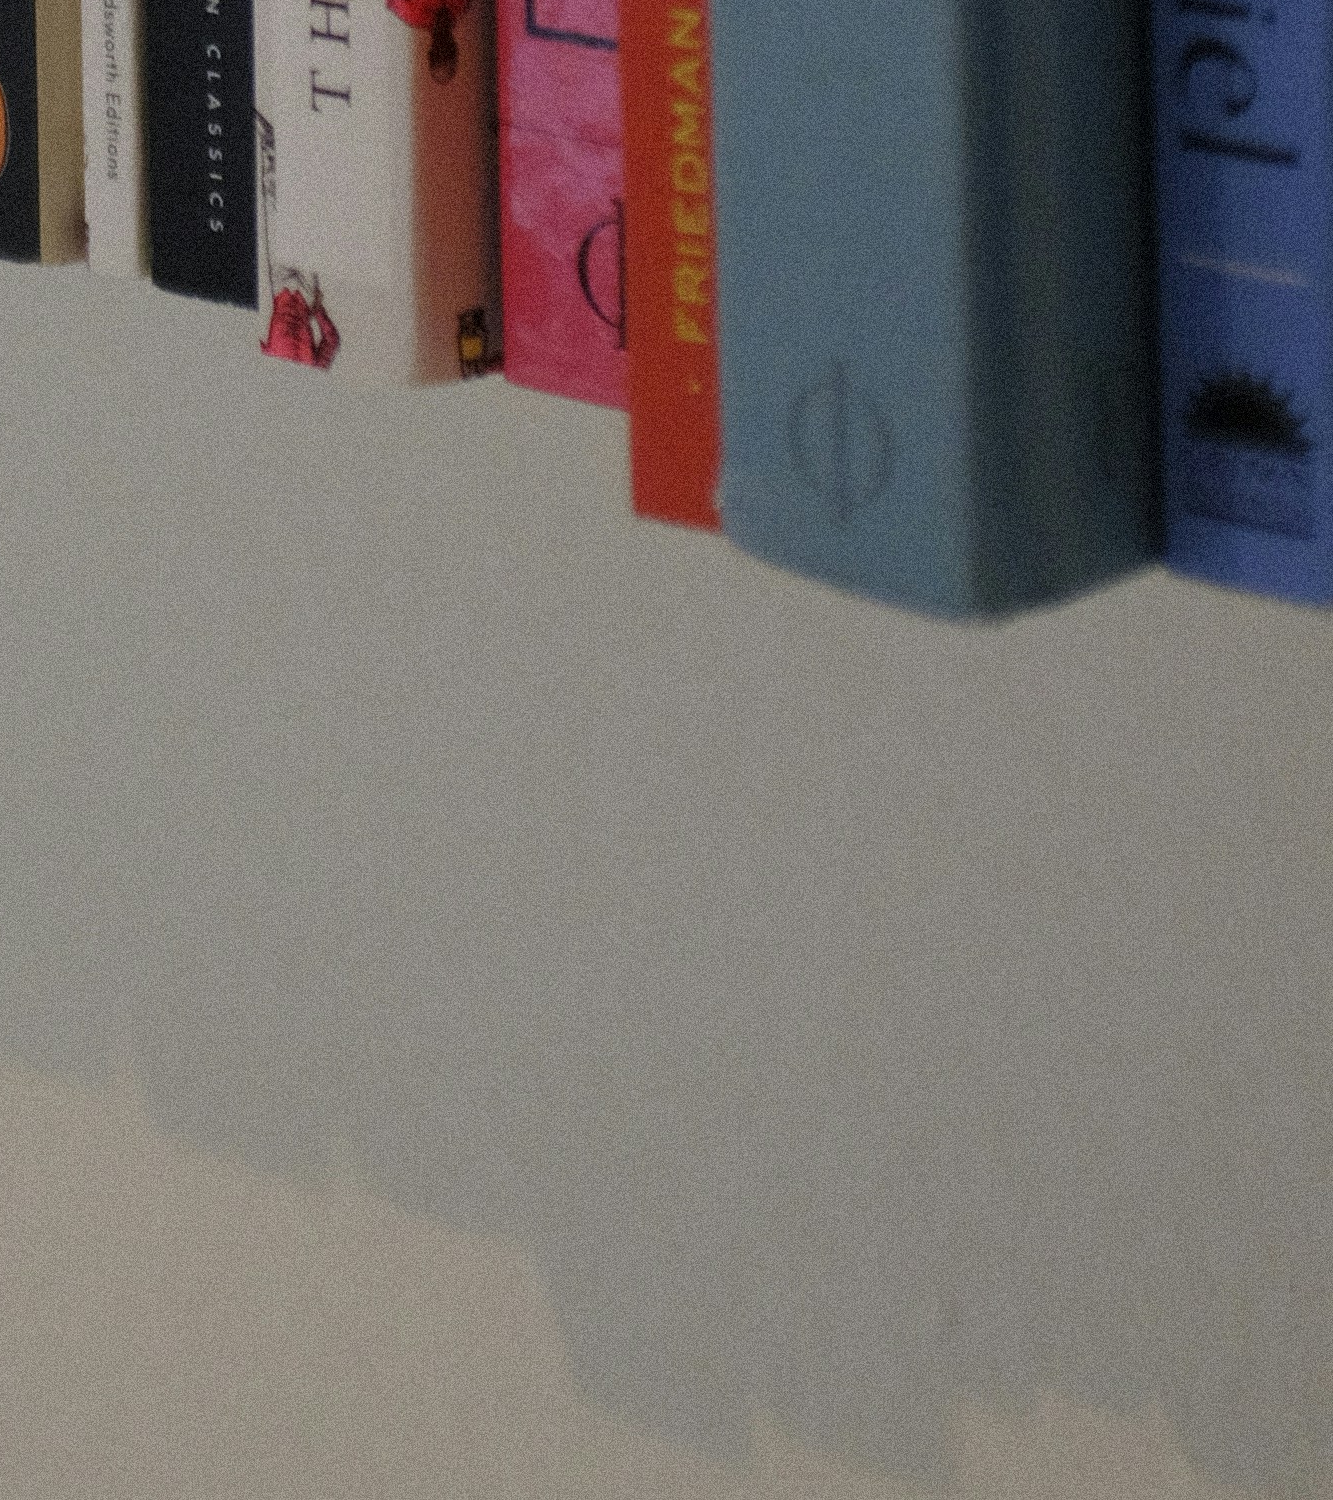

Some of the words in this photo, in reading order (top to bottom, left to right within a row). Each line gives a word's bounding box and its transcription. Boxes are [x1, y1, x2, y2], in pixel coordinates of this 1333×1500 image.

[104, 92, 122, 181] Editions
[205, 43, 225, 235] CLASSICS
[669, 6, 710, 345] FRIEDMAN
